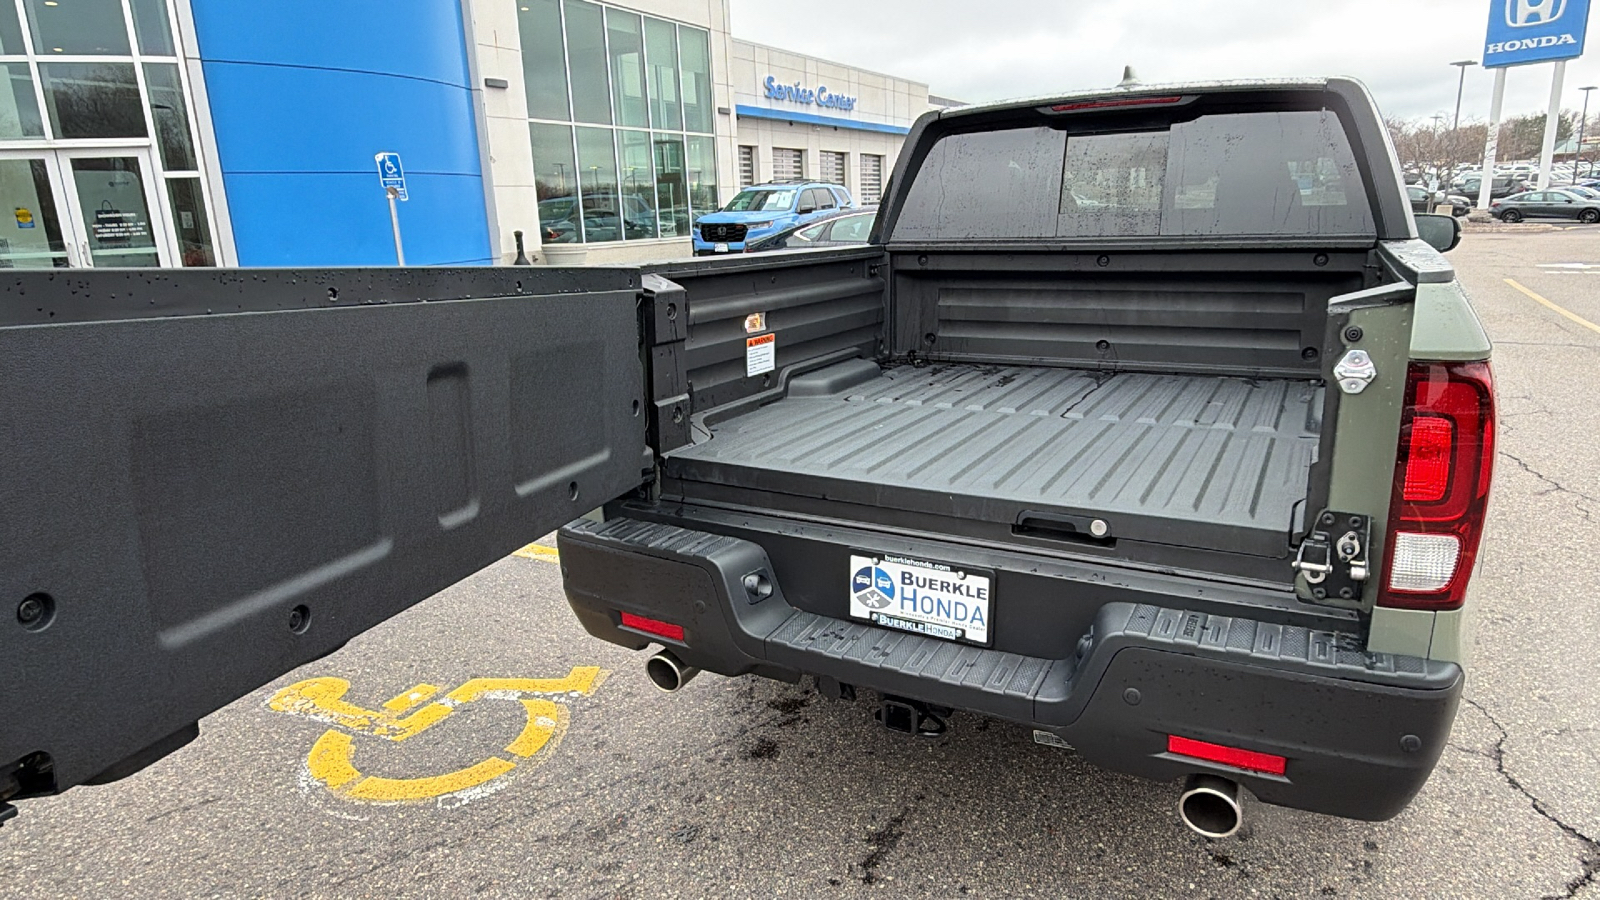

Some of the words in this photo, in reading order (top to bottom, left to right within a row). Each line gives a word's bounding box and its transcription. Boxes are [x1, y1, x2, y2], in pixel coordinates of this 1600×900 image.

[1486, 33, 1577, 54] HONDA
[763, 75, 814, 104] Service
[815, 86, 857, 110] Center
[884, 554, 951, 572] buerklehonda.com
[900, 570, 987, 601] BUERKLE
[900, 586, 986, 627] HONDA
[879, 614, 926, 633] BUERKLE
[926, 624, 954, 638] HONDA
